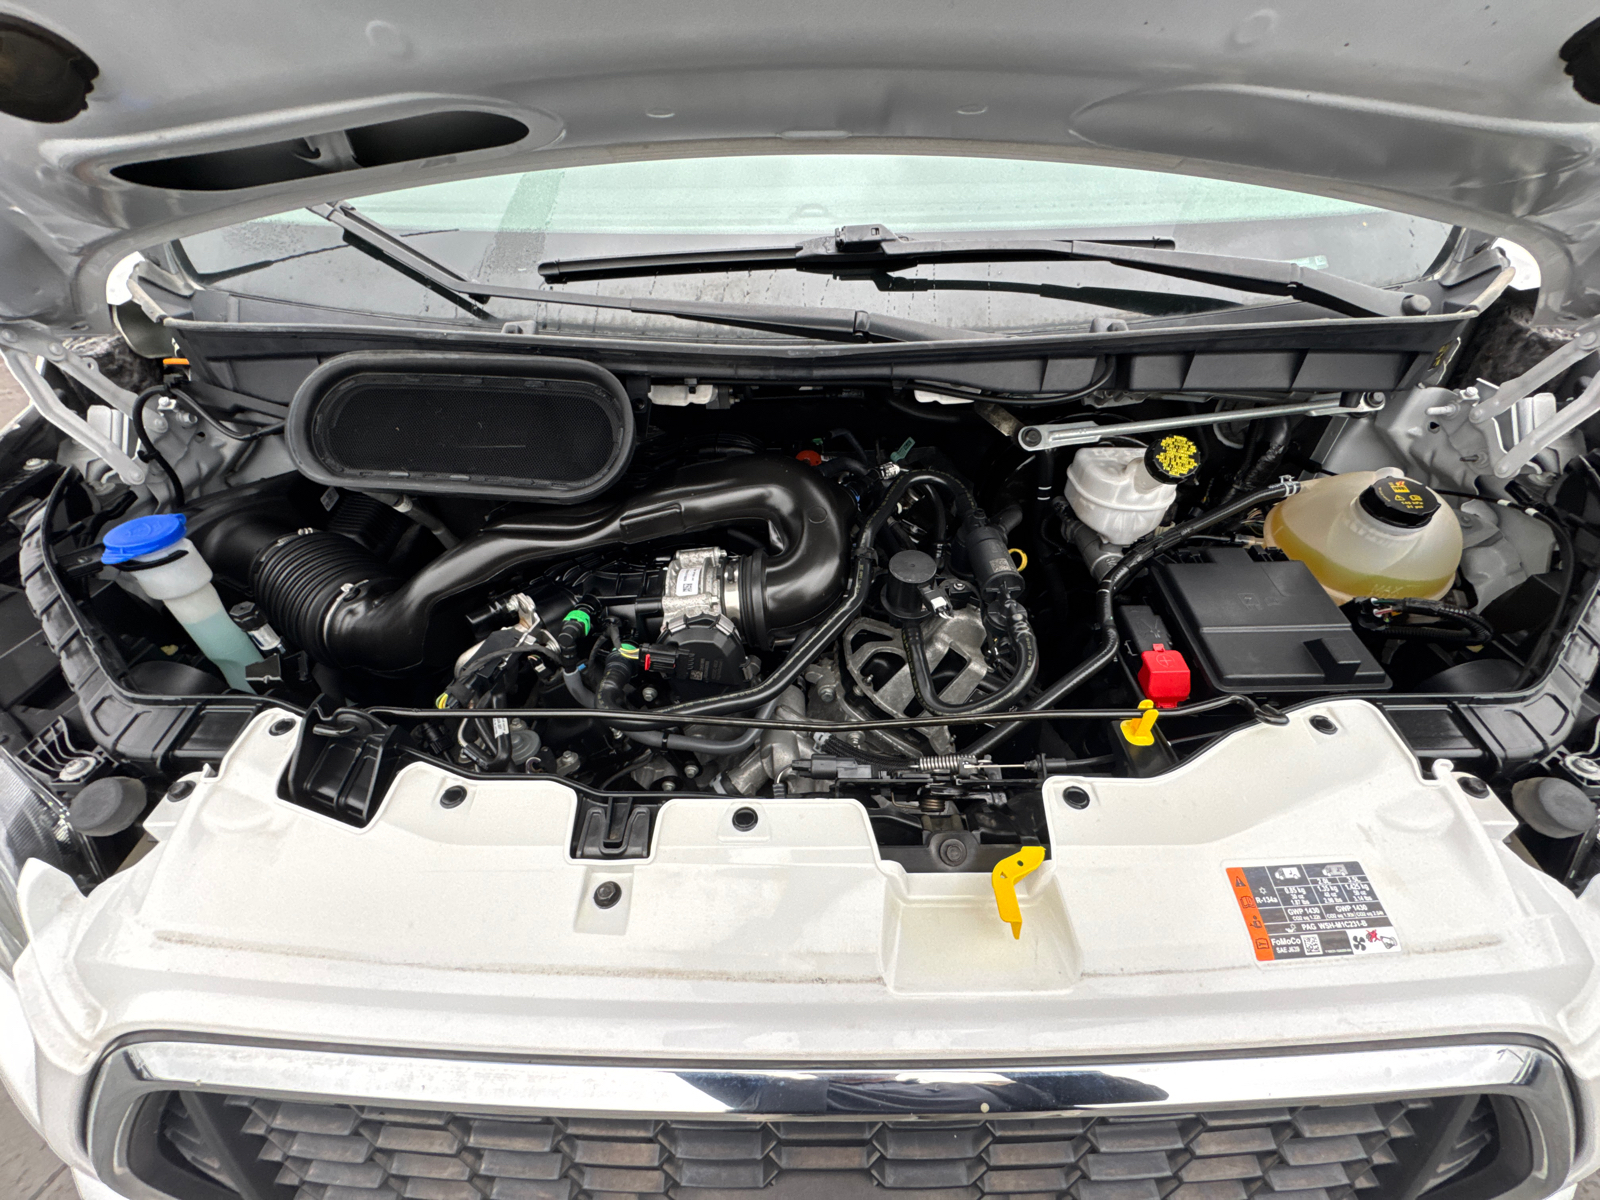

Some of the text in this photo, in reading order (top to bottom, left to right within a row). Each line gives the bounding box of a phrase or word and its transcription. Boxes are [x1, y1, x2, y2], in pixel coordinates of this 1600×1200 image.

[1301, 920, 1368, 931] PAG WSH-M1C231-B
[1270, 937, 1301, 946] FoMoCo
